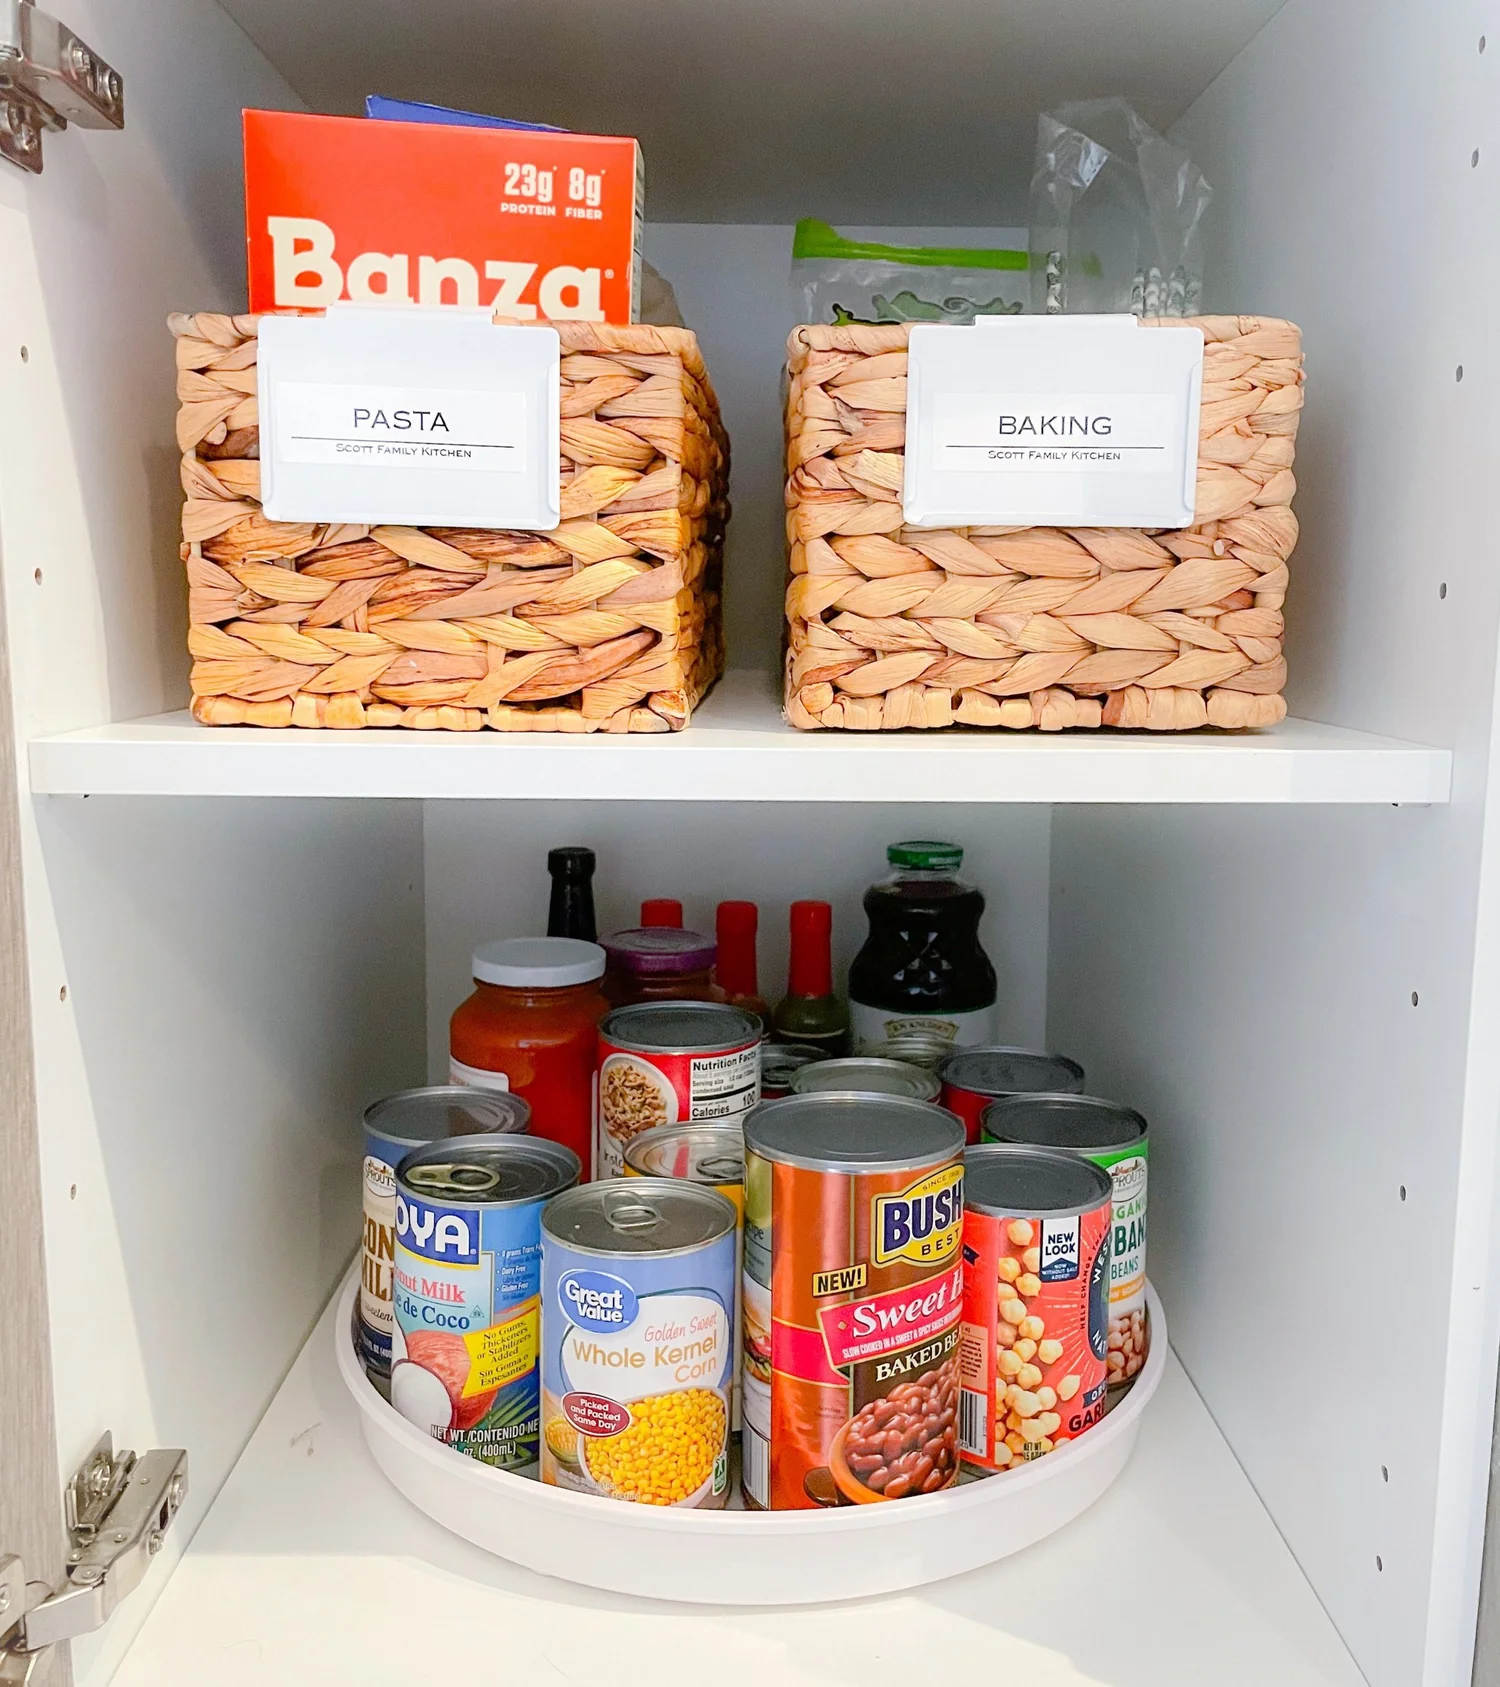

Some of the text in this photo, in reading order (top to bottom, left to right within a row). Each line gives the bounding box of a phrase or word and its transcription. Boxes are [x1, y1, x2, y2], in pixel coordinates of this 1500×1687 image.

[500, 202, 603, 220] PROTEIN FIBER
[354, 408, 449, 432] PASTA
[999, 415, 1112, 436] BAKING
[692, 1058, 737, 1071] Nutrition
[738, 1051, 757, 1064] Facts
[692, 1105, 730, 1117] Calories
[922, 1175, 947, 1192] SINCE
[884, 1179, 962, 1254] BUSH
[921, 1228, 960, 1256] BEST
[1048, 1232, 1074, 1244] NEW
[1045, 1243, 1075, 1256] LOOK
[515, 1265, 526, 1273] Free
[1080, 1256, 1092, 1299] CHANGE
[1111, 1256, 1139, 1280] BEANS
[421, 1277, 466, 1304] Milk
[518, 1281, 529, 1290] Free
[817, 1267, 862, 1294] NEW!
[565, 1279, 623, 1310] Great
[403, 1297, 418, 1318] de
[421, 1305, 470, 1330] Coco
[577, 1301, 623, 1323] Value
[853, 1281, 947, 1338] Sweet
[484, 1332, 496, 1342] No
[644, 1313, 717, 1342] Golden Sweet
[481, 1328, 528, 1350] Thickeners
[488, 1333, 532, 1357] Stabilizers
[572, 1329, 717, 1369] Whole Kernel
[842, 1345, 860, 1359] SLOW
[860, 1340, 884, 1355] COOKED
[896, 1330, 913, 1343] SWEET
[490, 1346, 519, 1364] Added
[876, 1341, 942, 1382] BAKED
[479, 1369, 493, 1378] Sin
[495, 1358, 522, 1373] Goma
[480, 1363, 527, 1387] Espesantes
[674, 1356, 716, 1383] Corn
[570, 1405, 621, 1422] and Packed
[580, 1398, 609, 1412] Picked
[431, 1424, 448, 1440] NET
[573, 1413, 616, 1432] Same Day
[478, 1441, 516, 1459] (400mL)
[613, 1491, 641, 1501] texture
